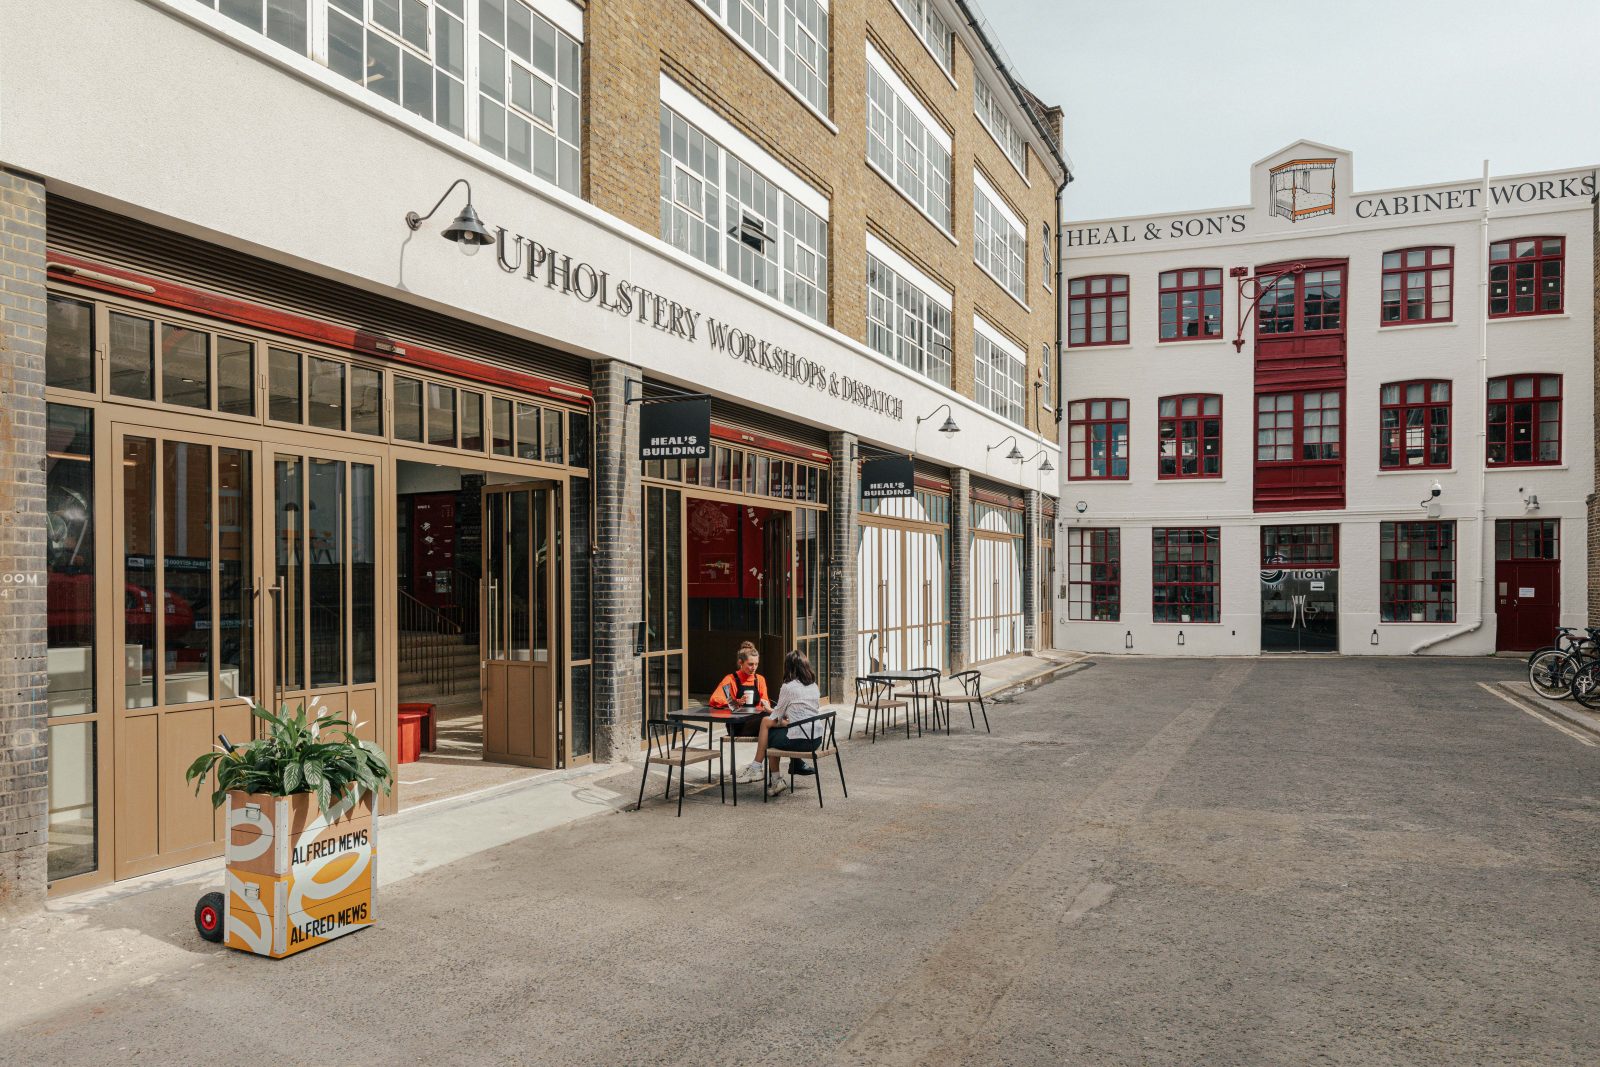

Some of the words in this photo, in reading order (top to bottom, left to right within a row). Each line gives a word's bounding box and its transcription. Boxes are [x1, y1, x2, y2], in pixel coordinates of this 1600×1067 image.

[1067, 225, 1135, 247] HEAL
[1144, 222, 1162, 240] &
[1170, 214, 1246, 238] SON'S
[1355, 188, 1481, 219] CABINET
[1489, 175, 1596, 205] WORKS
[495, 225, 701, 341] UPHOLSTERY
[707, 317, 826, 391] WORKSHOPS
[829, 371, 840, 396] &
[841, 375, 903, 421] DISPATCH
[642, 446, 706, 456] BUILDING
[651, 435, 697, 446] HEAL'S
[0, 573, 38, 586] OOM
[292, 838, 335, 866] ALFRED
[338, 829, 368, 852] MEWS
[290, 914, 335, 946] ALFRED
[338, 902, 367, 928] MEWS
